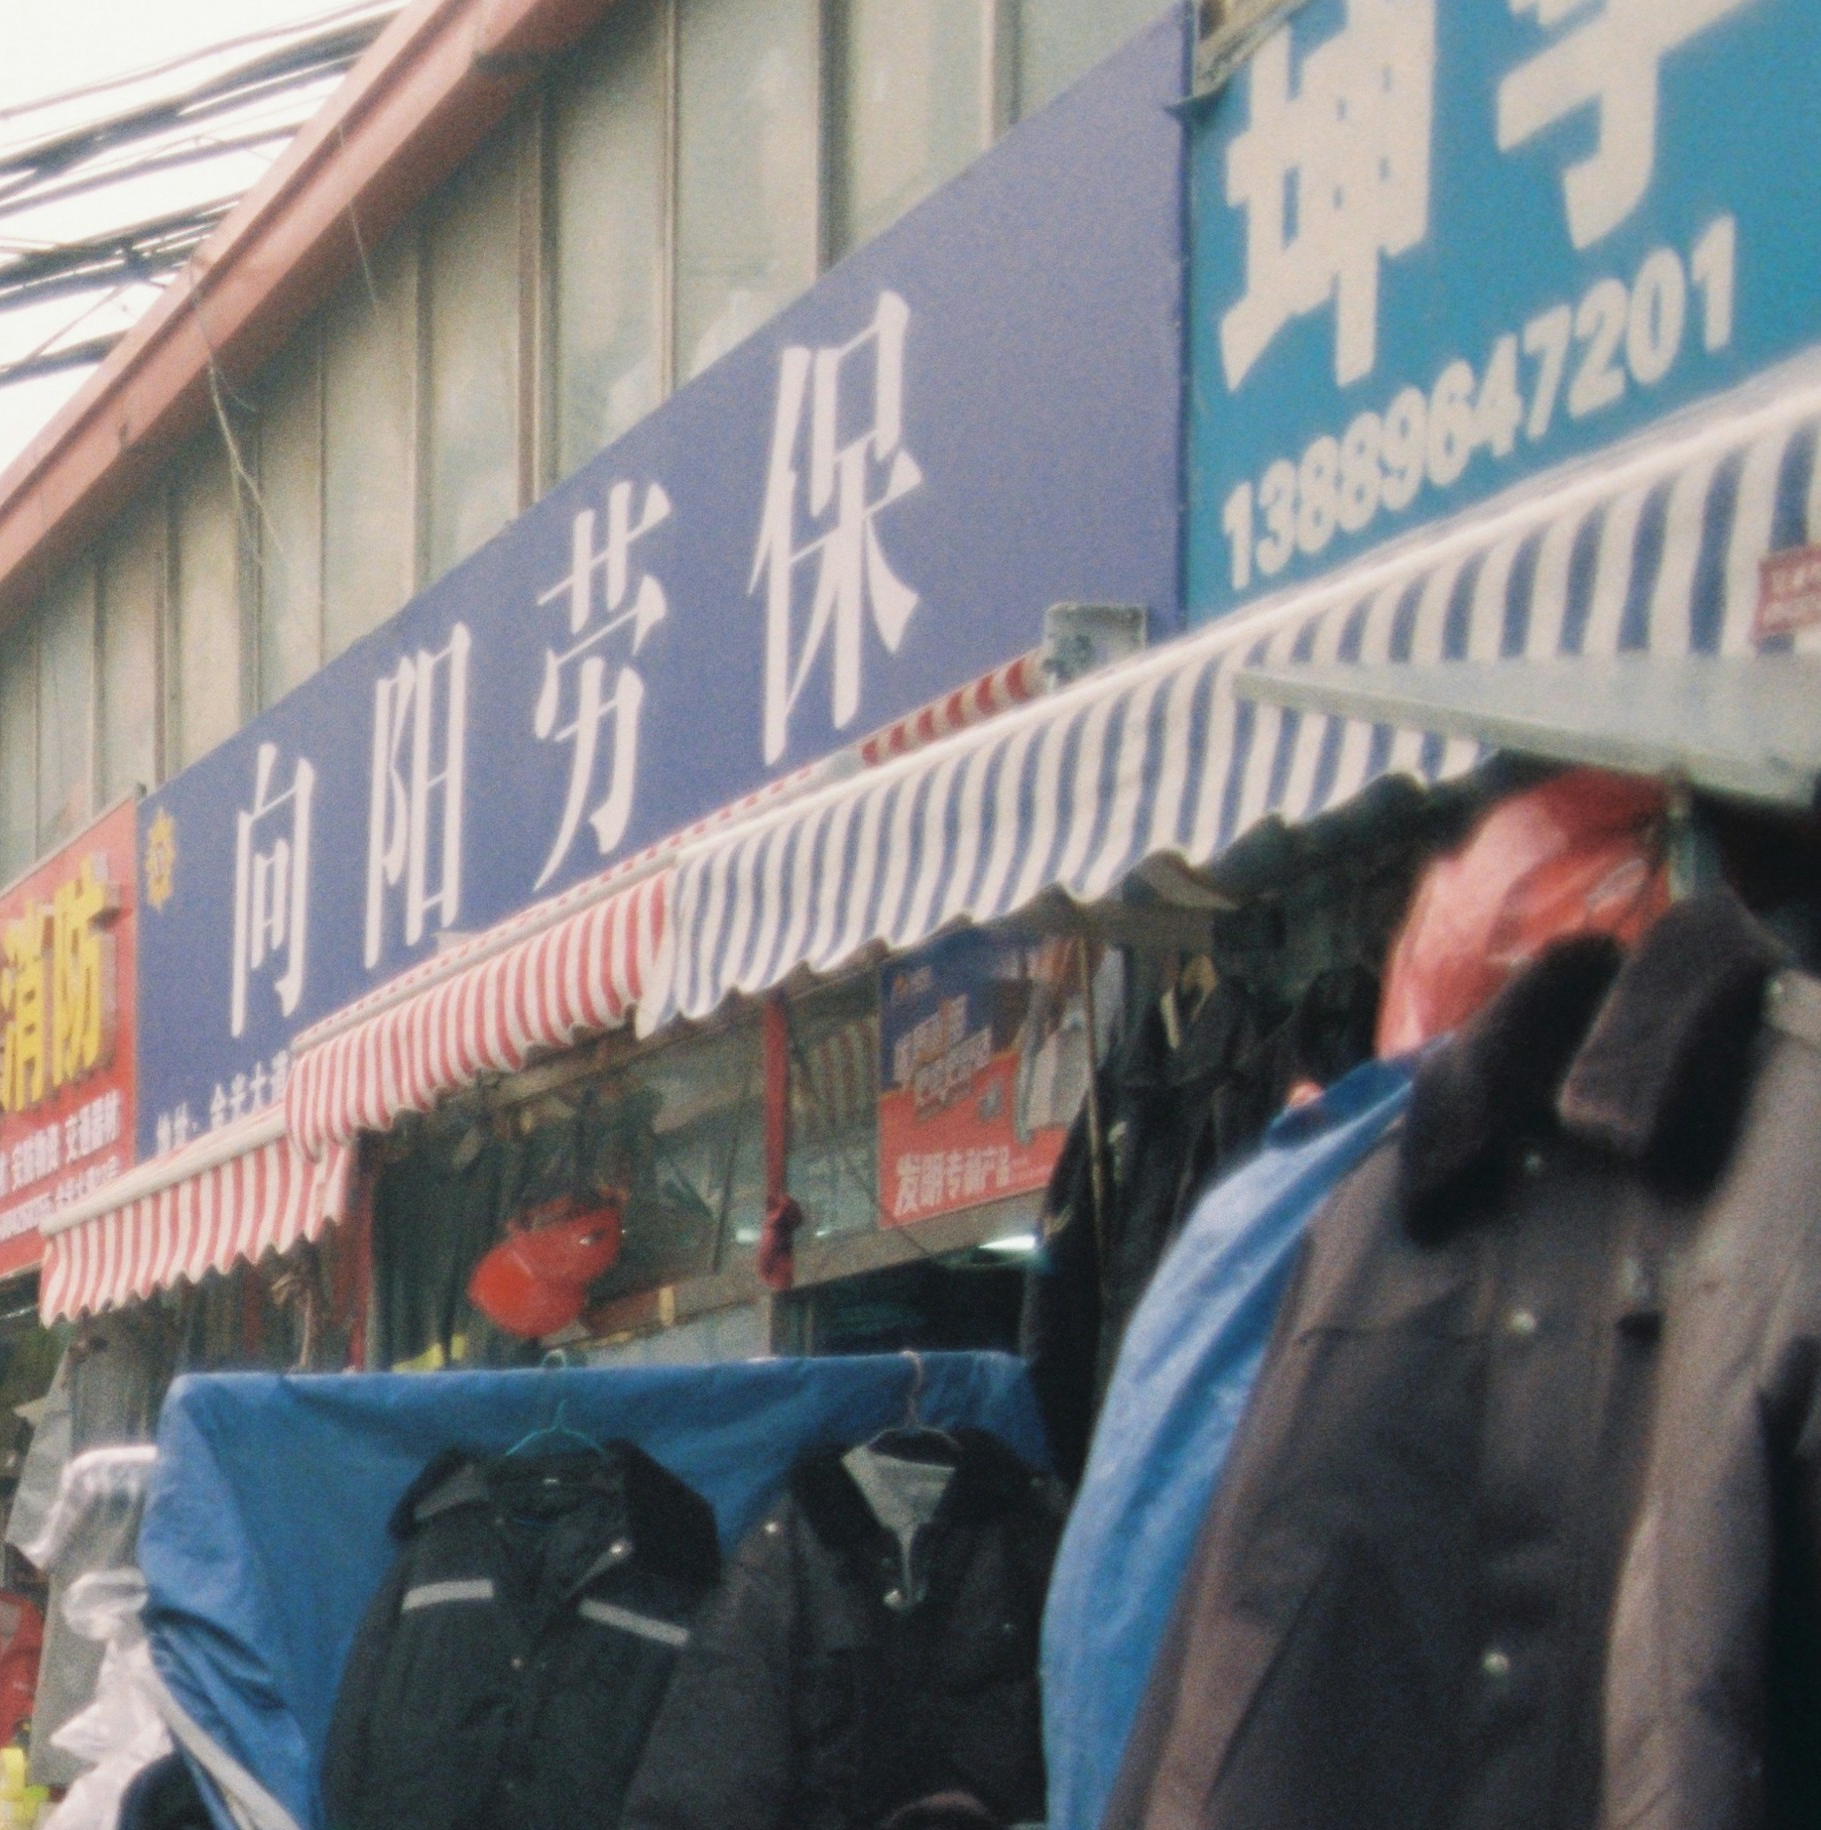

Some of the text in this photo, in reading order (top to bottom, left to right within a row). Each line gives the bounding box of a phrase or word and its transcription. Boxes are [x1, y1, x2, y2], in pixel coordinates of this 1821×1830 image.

[231, 290, 923, 1038] 向阳劳保
[1221, 213, 1736, 590] 13889647201
